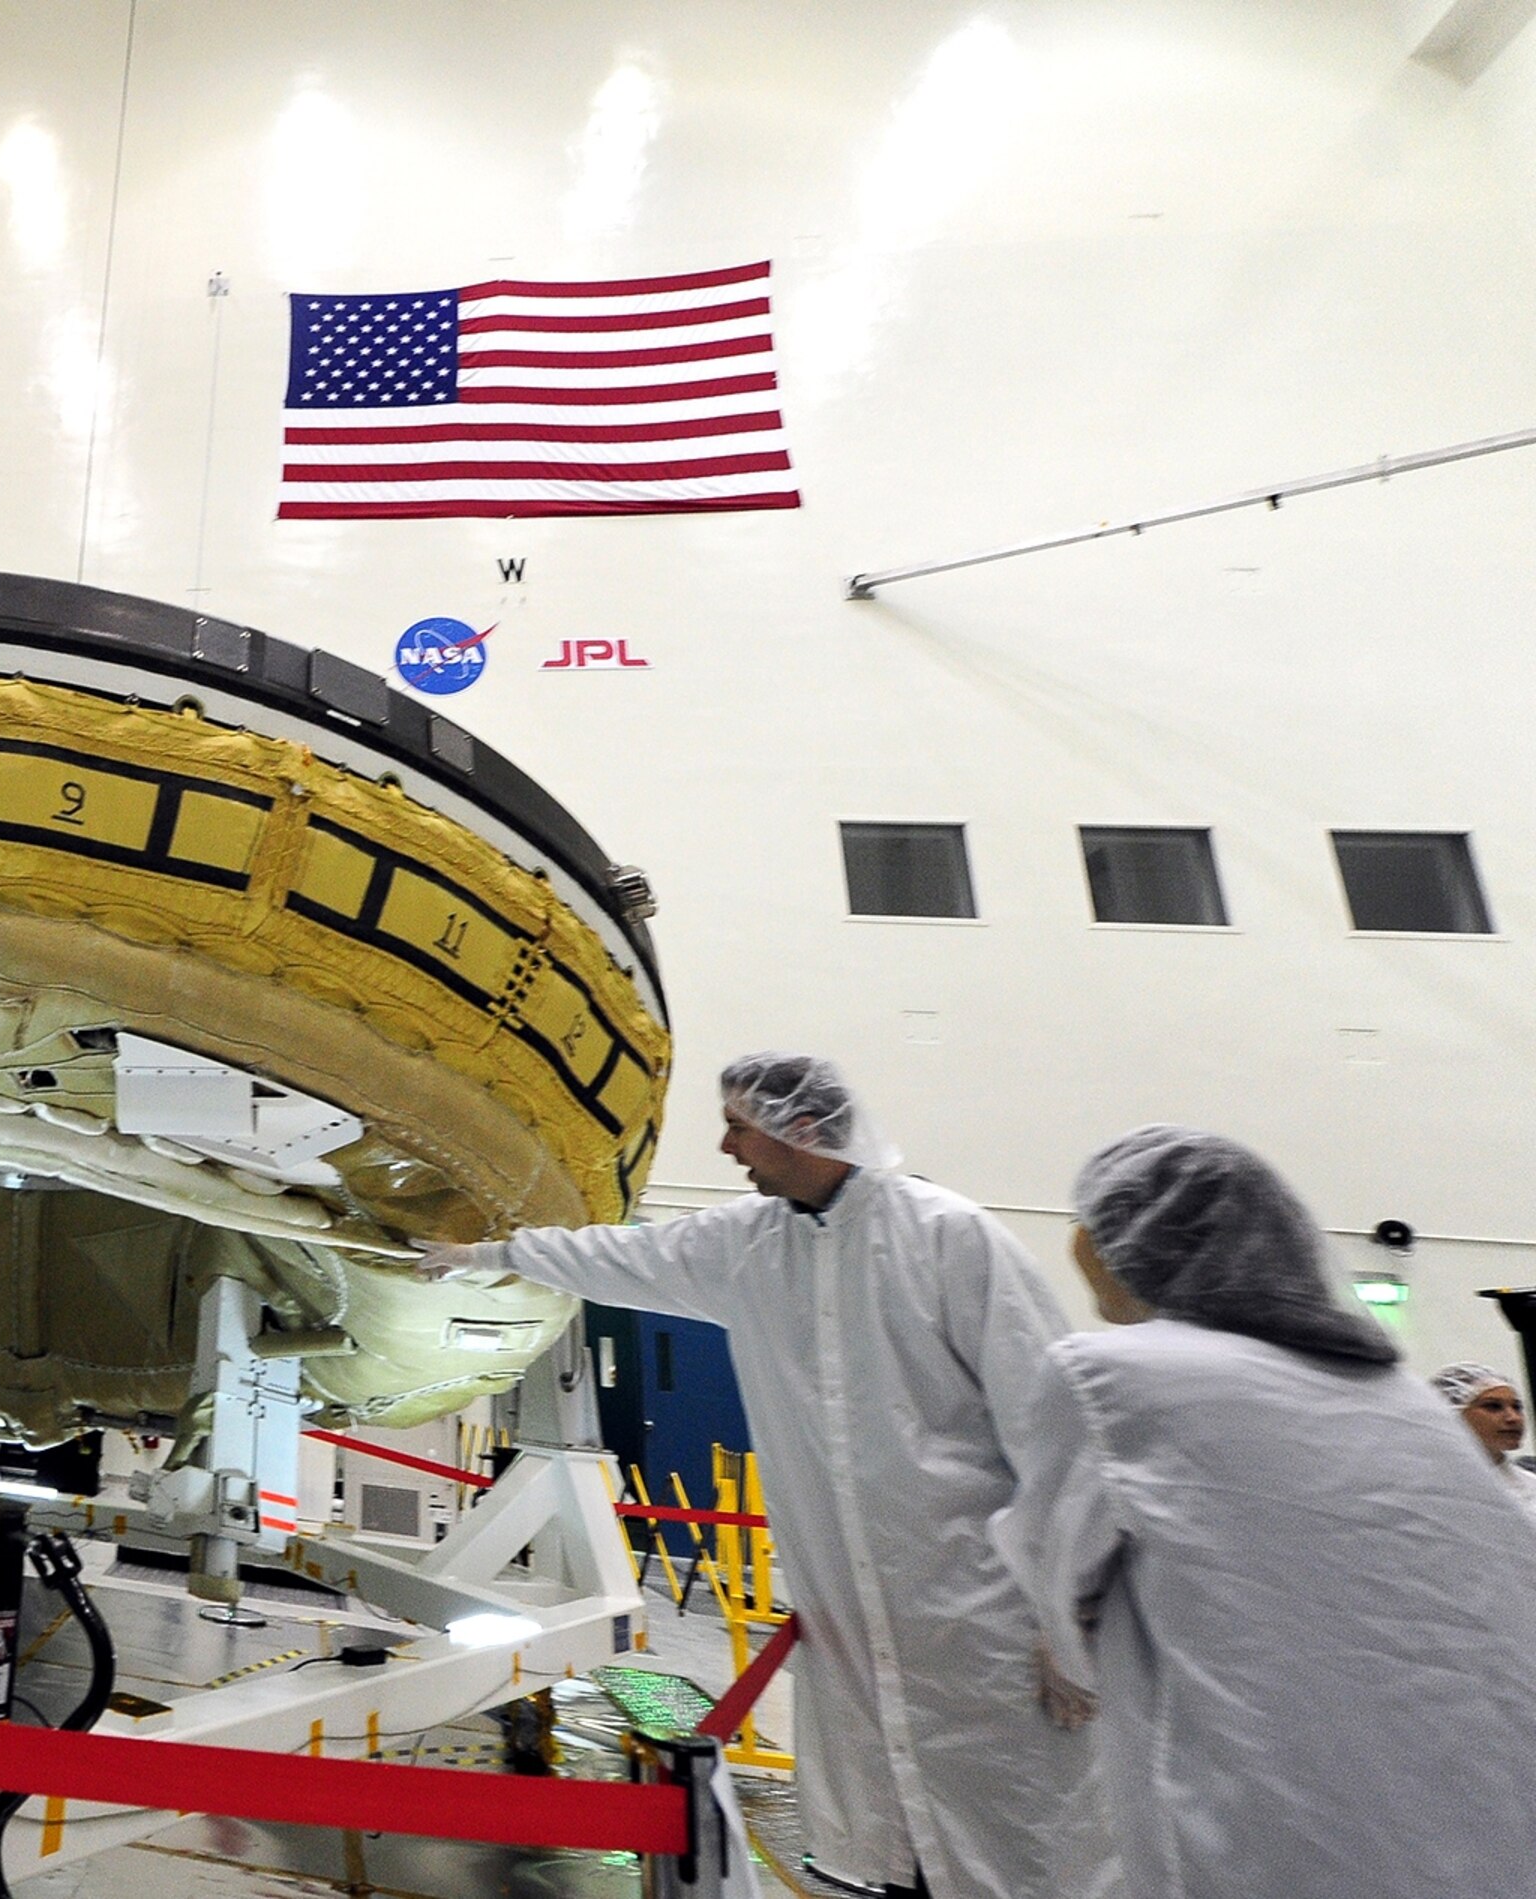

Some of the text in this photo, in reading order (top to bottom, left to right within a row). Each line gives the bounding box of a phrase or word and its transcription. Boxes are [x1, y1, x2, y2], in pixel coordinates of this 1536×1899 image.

[497, 557, 527, 584] W
[399, 647, 485, 666] NASA
[543, 639, 649, 668] JPL
[56, 781, 87, 821] 9
[435, 912, 469, 956] 11
